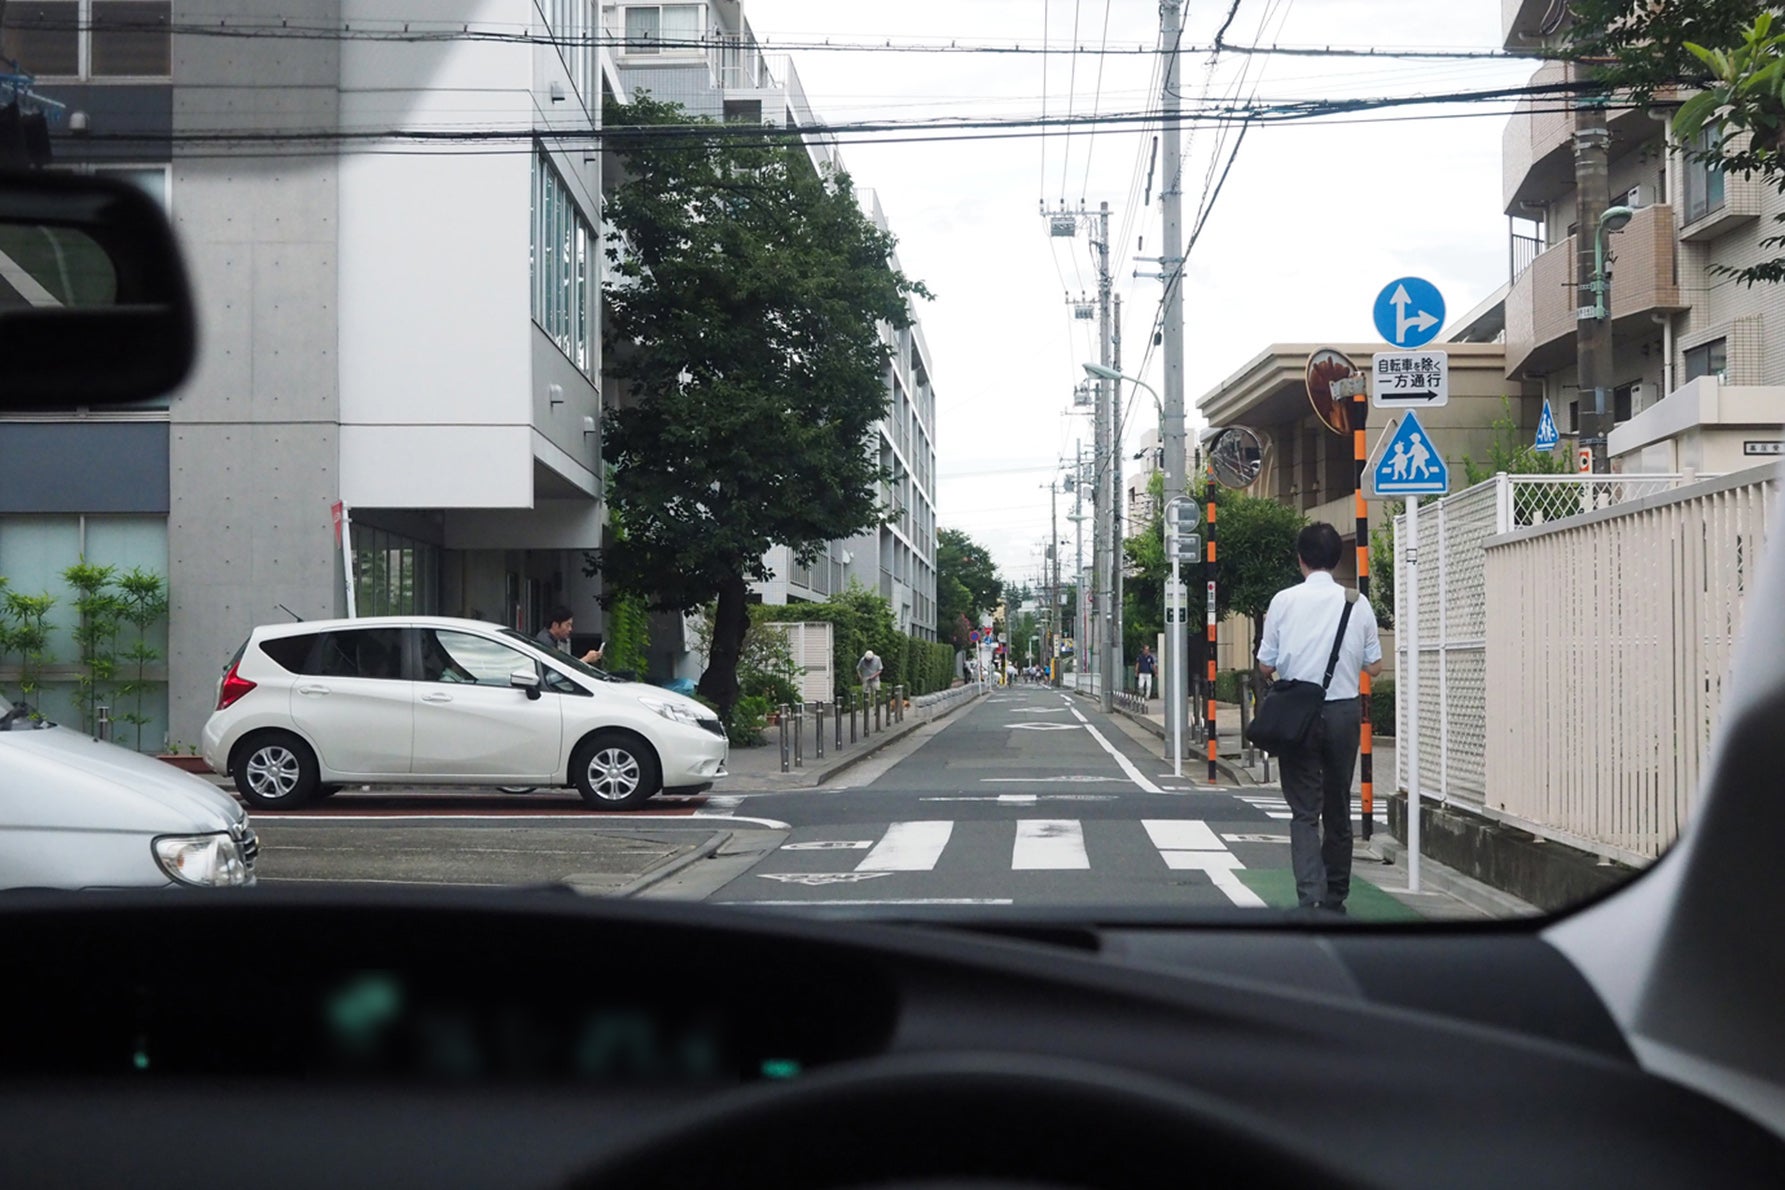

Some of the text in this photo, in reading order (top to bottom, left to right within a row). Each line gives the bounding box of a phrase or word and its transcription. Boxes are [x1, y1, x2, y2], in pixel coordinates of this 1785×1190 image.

[1378, 357, 1441, 372] 自転車を除く
[1378, 373, 1441, 388] 一方通行
